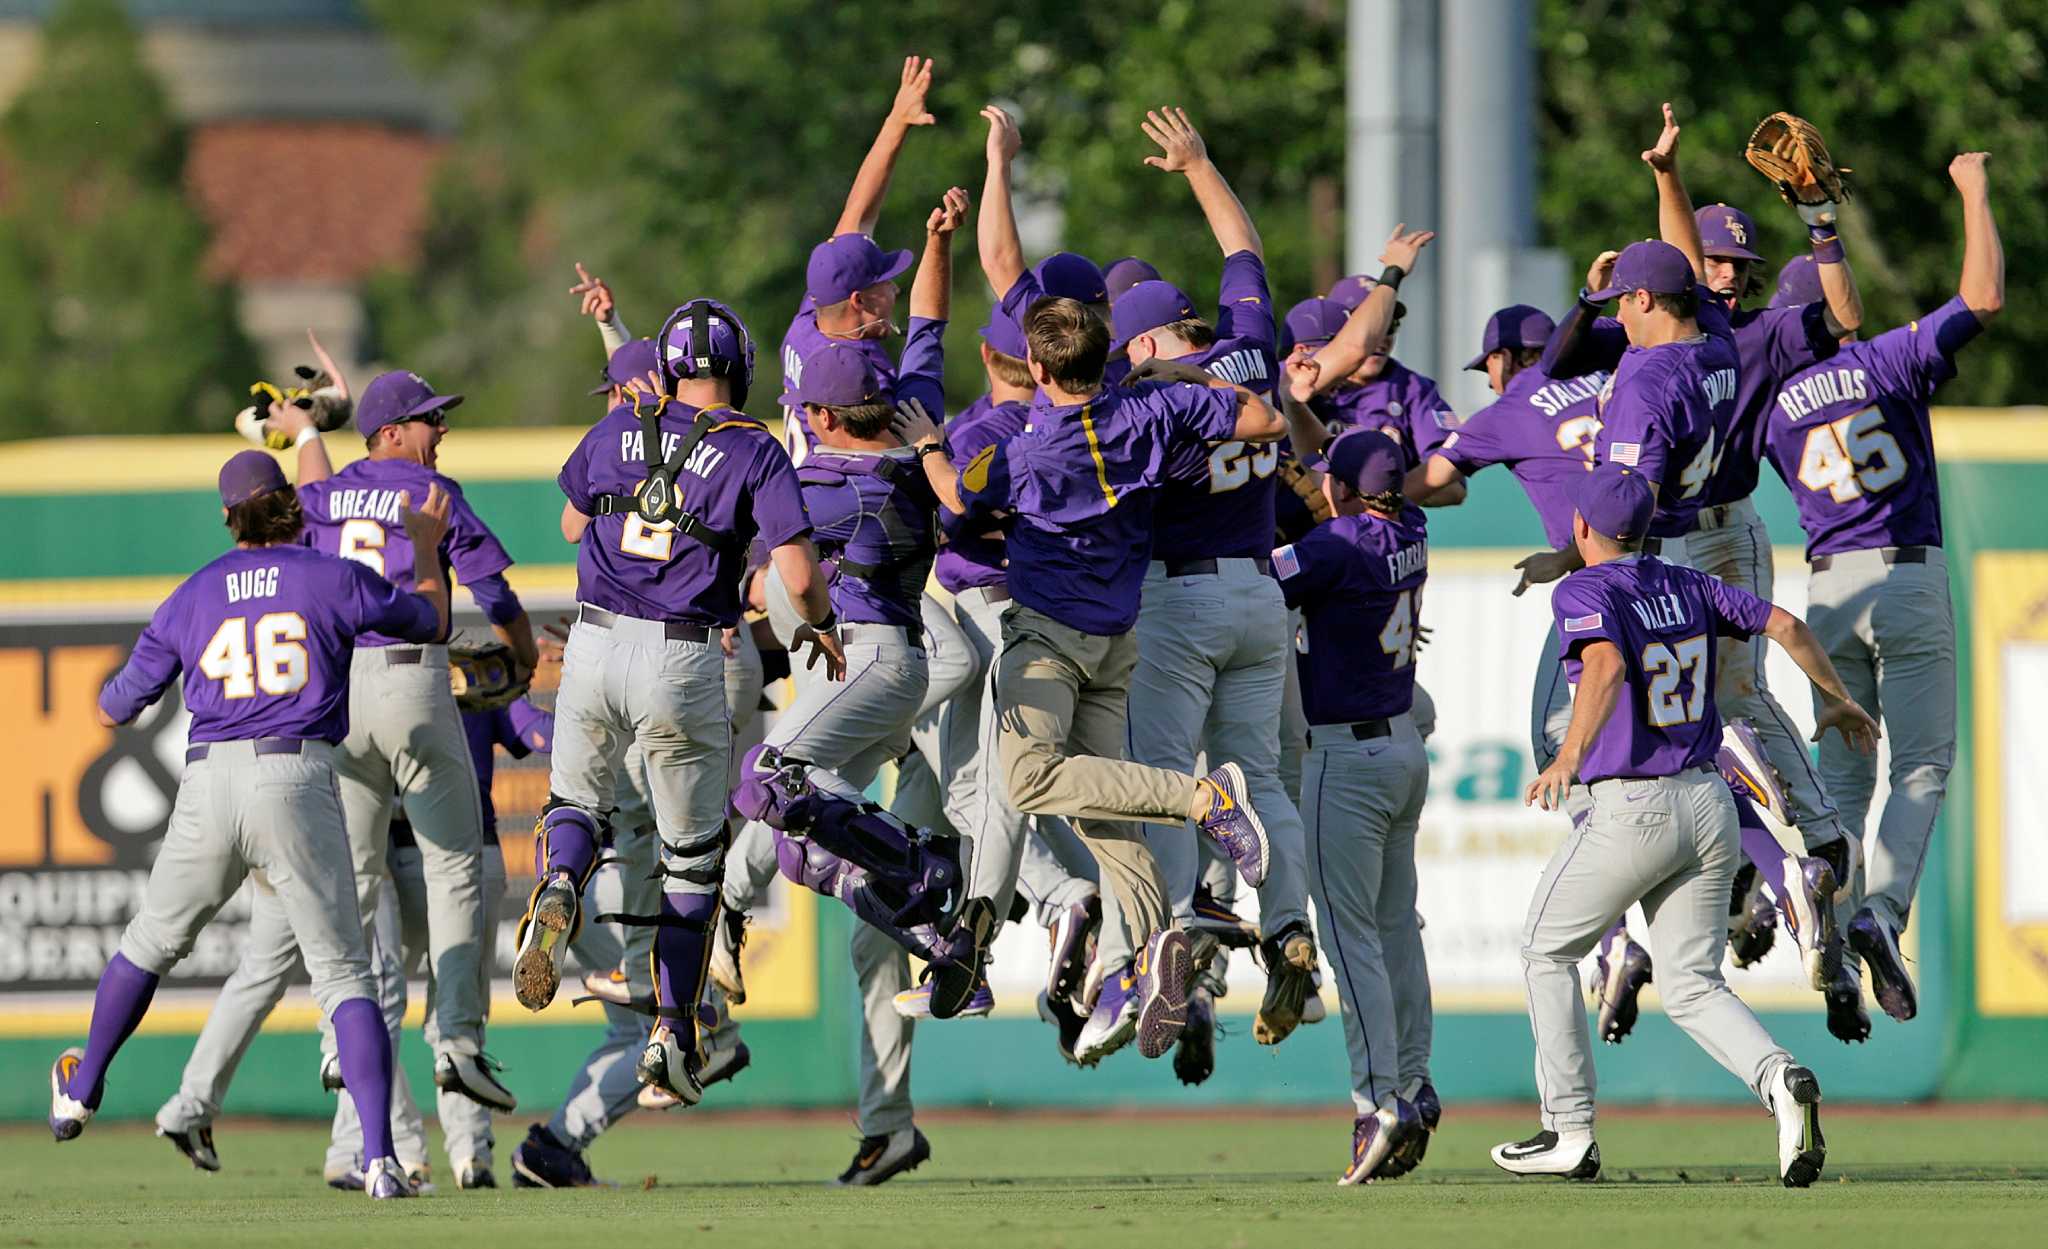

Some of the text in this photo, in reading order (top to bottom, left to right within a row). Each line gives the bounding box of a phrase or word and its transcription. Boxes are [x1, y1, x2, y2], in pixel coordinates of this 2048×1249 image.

[1204, 349, 1269, 385] ORDAN
[1777, 369, 1867, 422] REYNOLDS
[1797, 404, 1908, 504] 45
[329, 489, 402, 523] BREAUX
[339, 518, 387, 578] 6
[225, 566, 280, 603] BUGG
[198, 611, 310, 700] 46
[1641, 633, 1708, 727] 27
